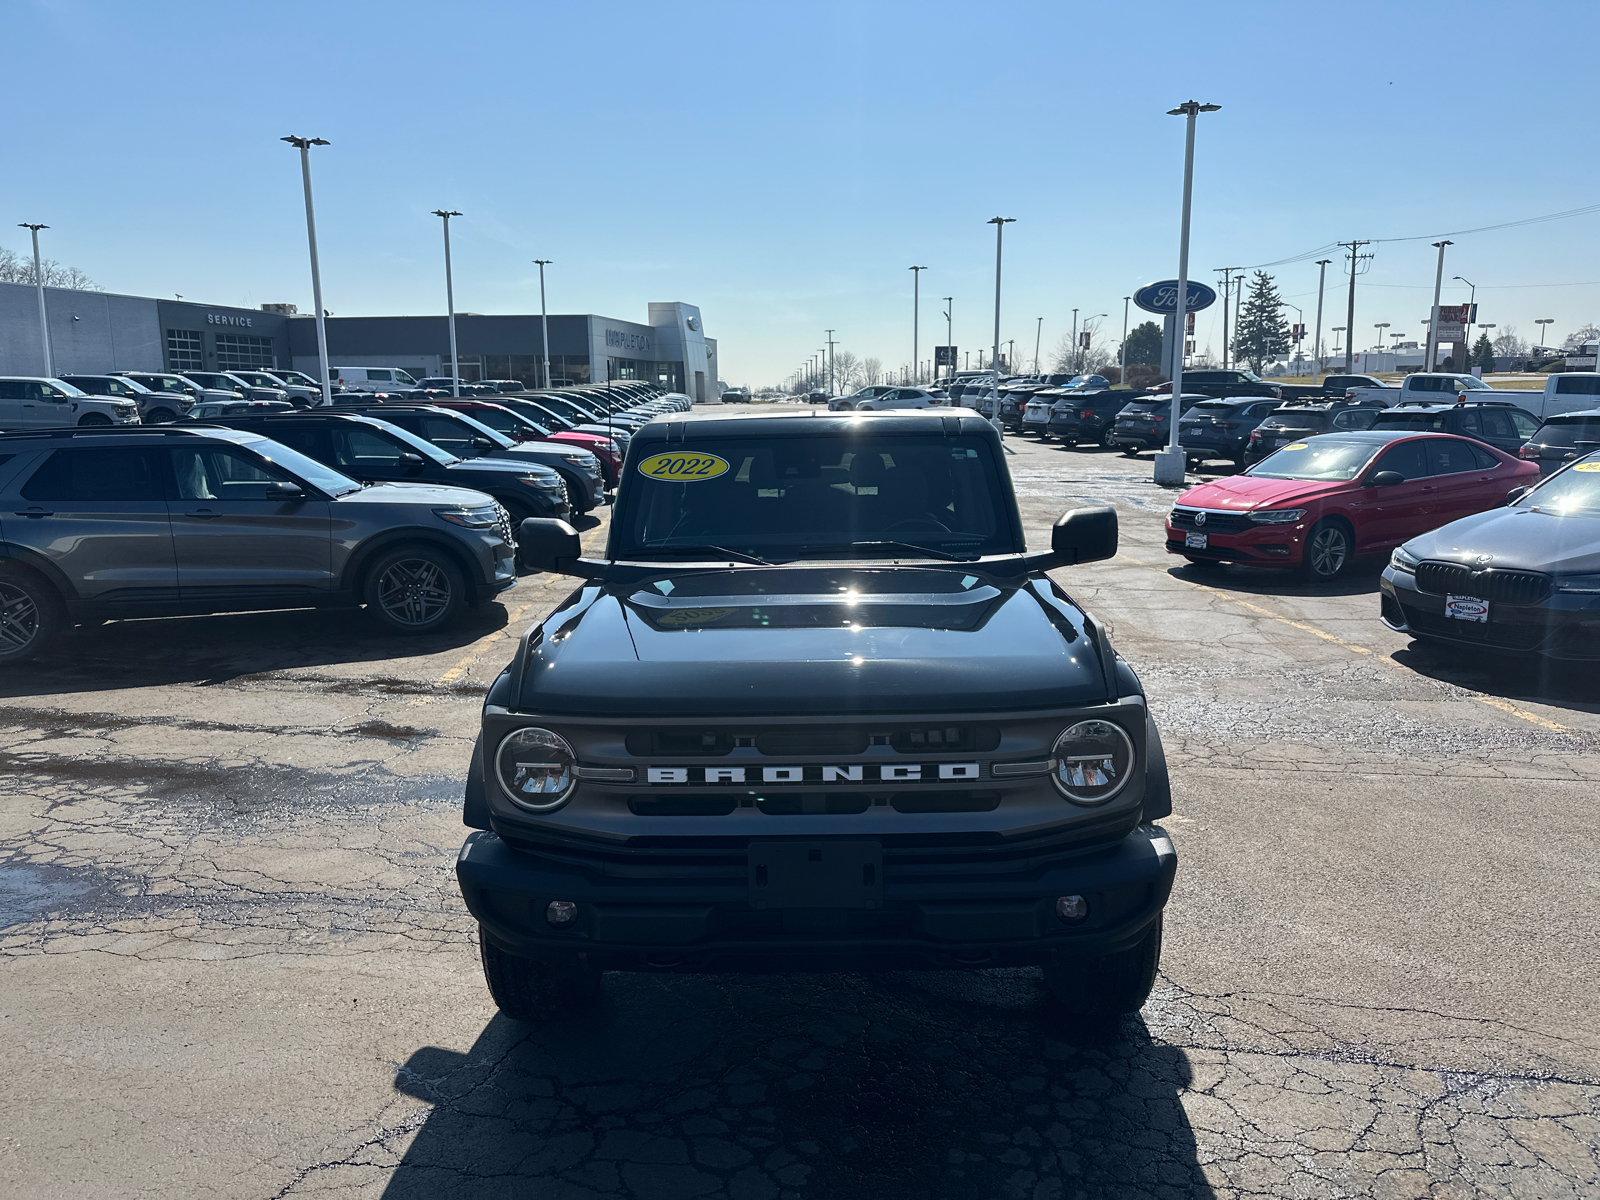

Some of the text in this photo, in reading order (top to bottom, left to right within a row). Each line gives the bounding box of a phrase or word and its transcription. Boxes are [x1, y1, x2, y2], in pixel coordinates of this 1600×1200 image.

[1153, 286, 1200, 306] Fod
[207, 314, 252, 327] SERVICE
[605, 329, 651, 352] NAPLETON
[651, 458, 716, 475] 2022
[1454, 603, 1481, 612] Napleton
[647, 763, 980, 783] BRONCO
